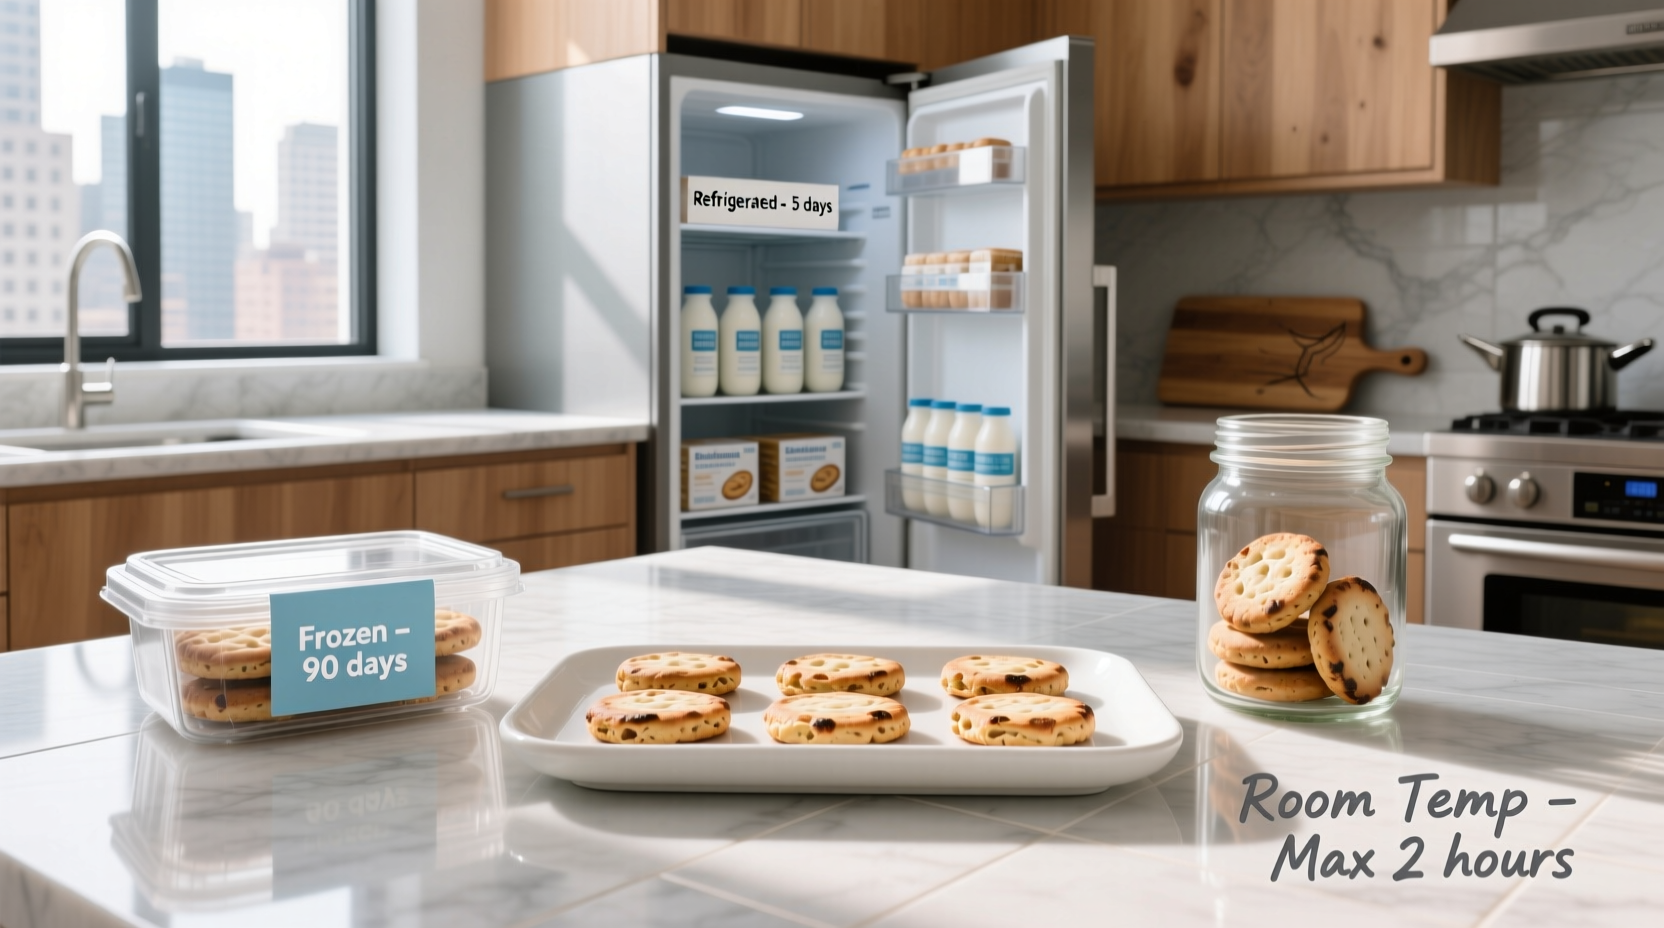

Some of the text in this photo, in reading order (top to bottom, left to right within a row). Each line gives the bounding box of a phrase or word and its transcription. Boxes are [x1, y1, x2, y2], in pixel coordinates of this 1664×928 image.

[791, 195, 800, 211] 5
[803, 196, 833, 217] days
[299, 624, 388, 651] Frozen
[302, 651, 408, 682] 90 days
